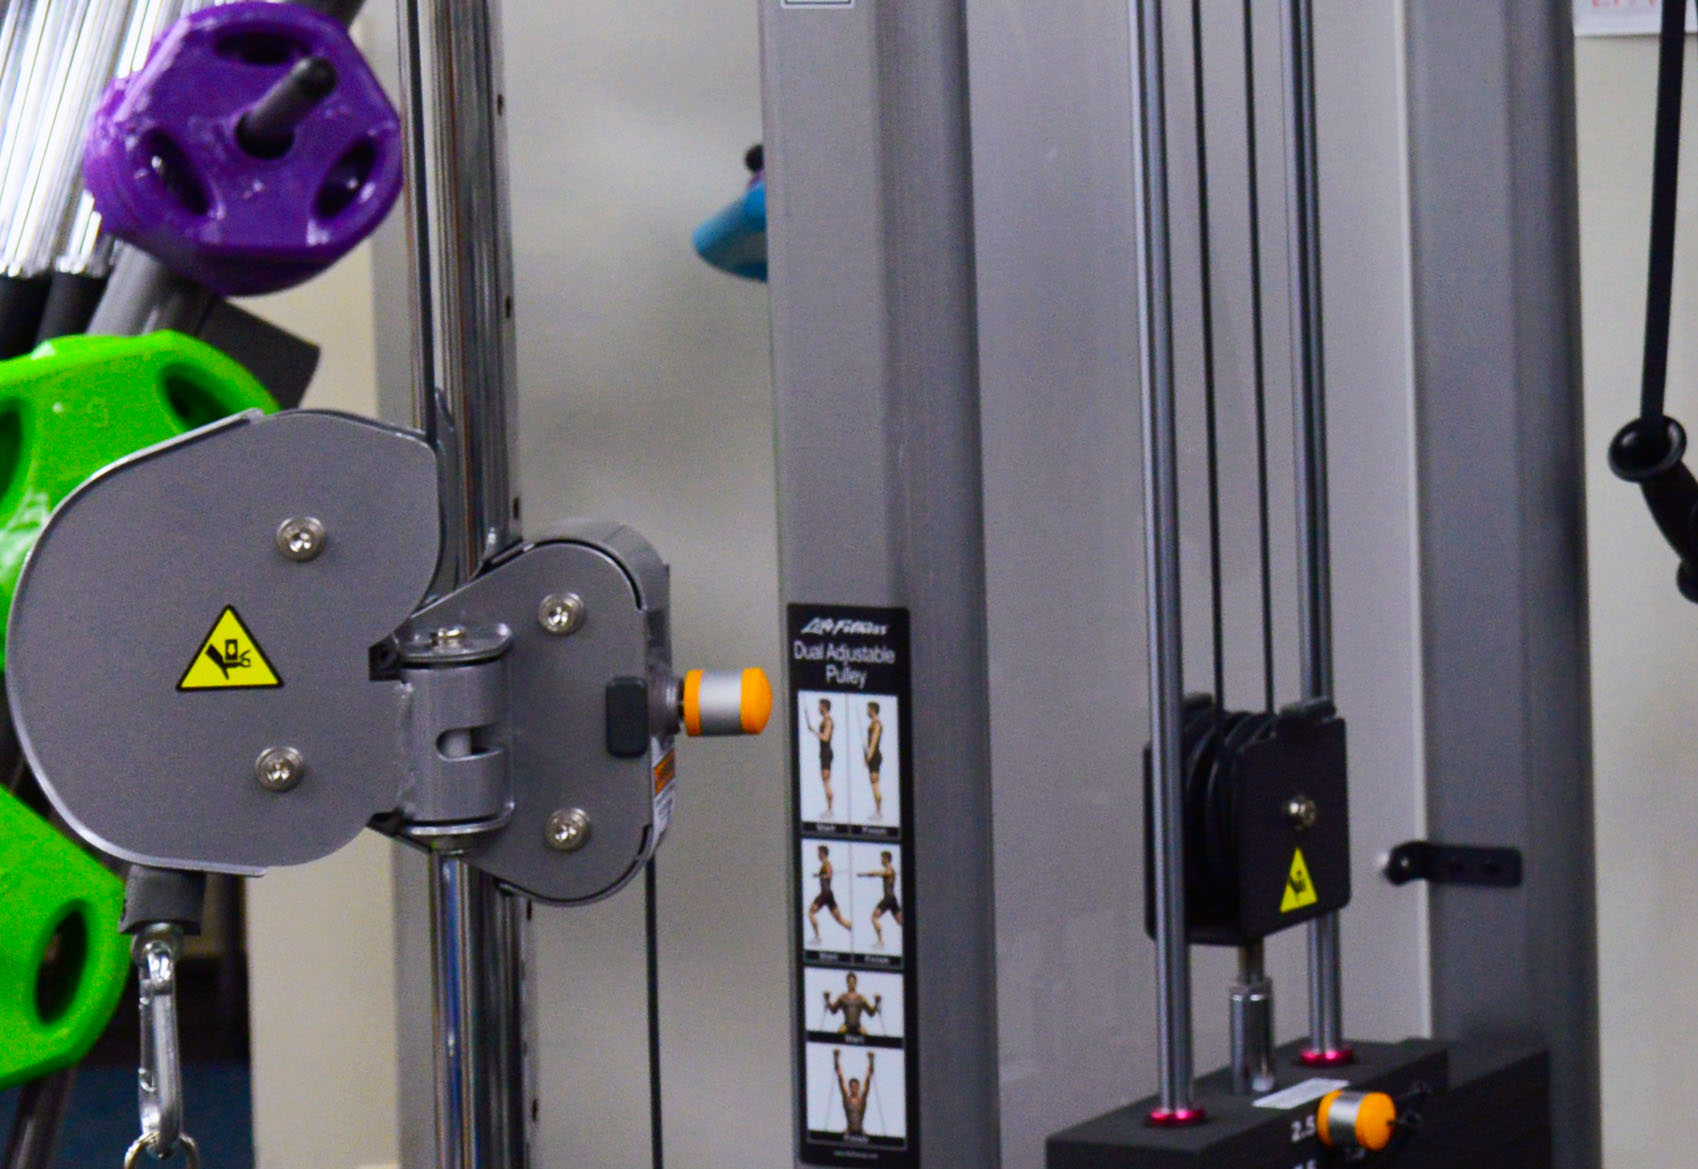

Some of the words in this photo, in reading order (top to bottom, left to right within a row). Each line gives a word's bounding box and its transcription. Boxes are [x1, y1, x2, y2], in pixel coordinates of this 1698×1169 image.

[793, 639, 824, 660] Dual
[825, 642, 896, 666] Adjustable
[825, 663, 868, 690] Pulley
